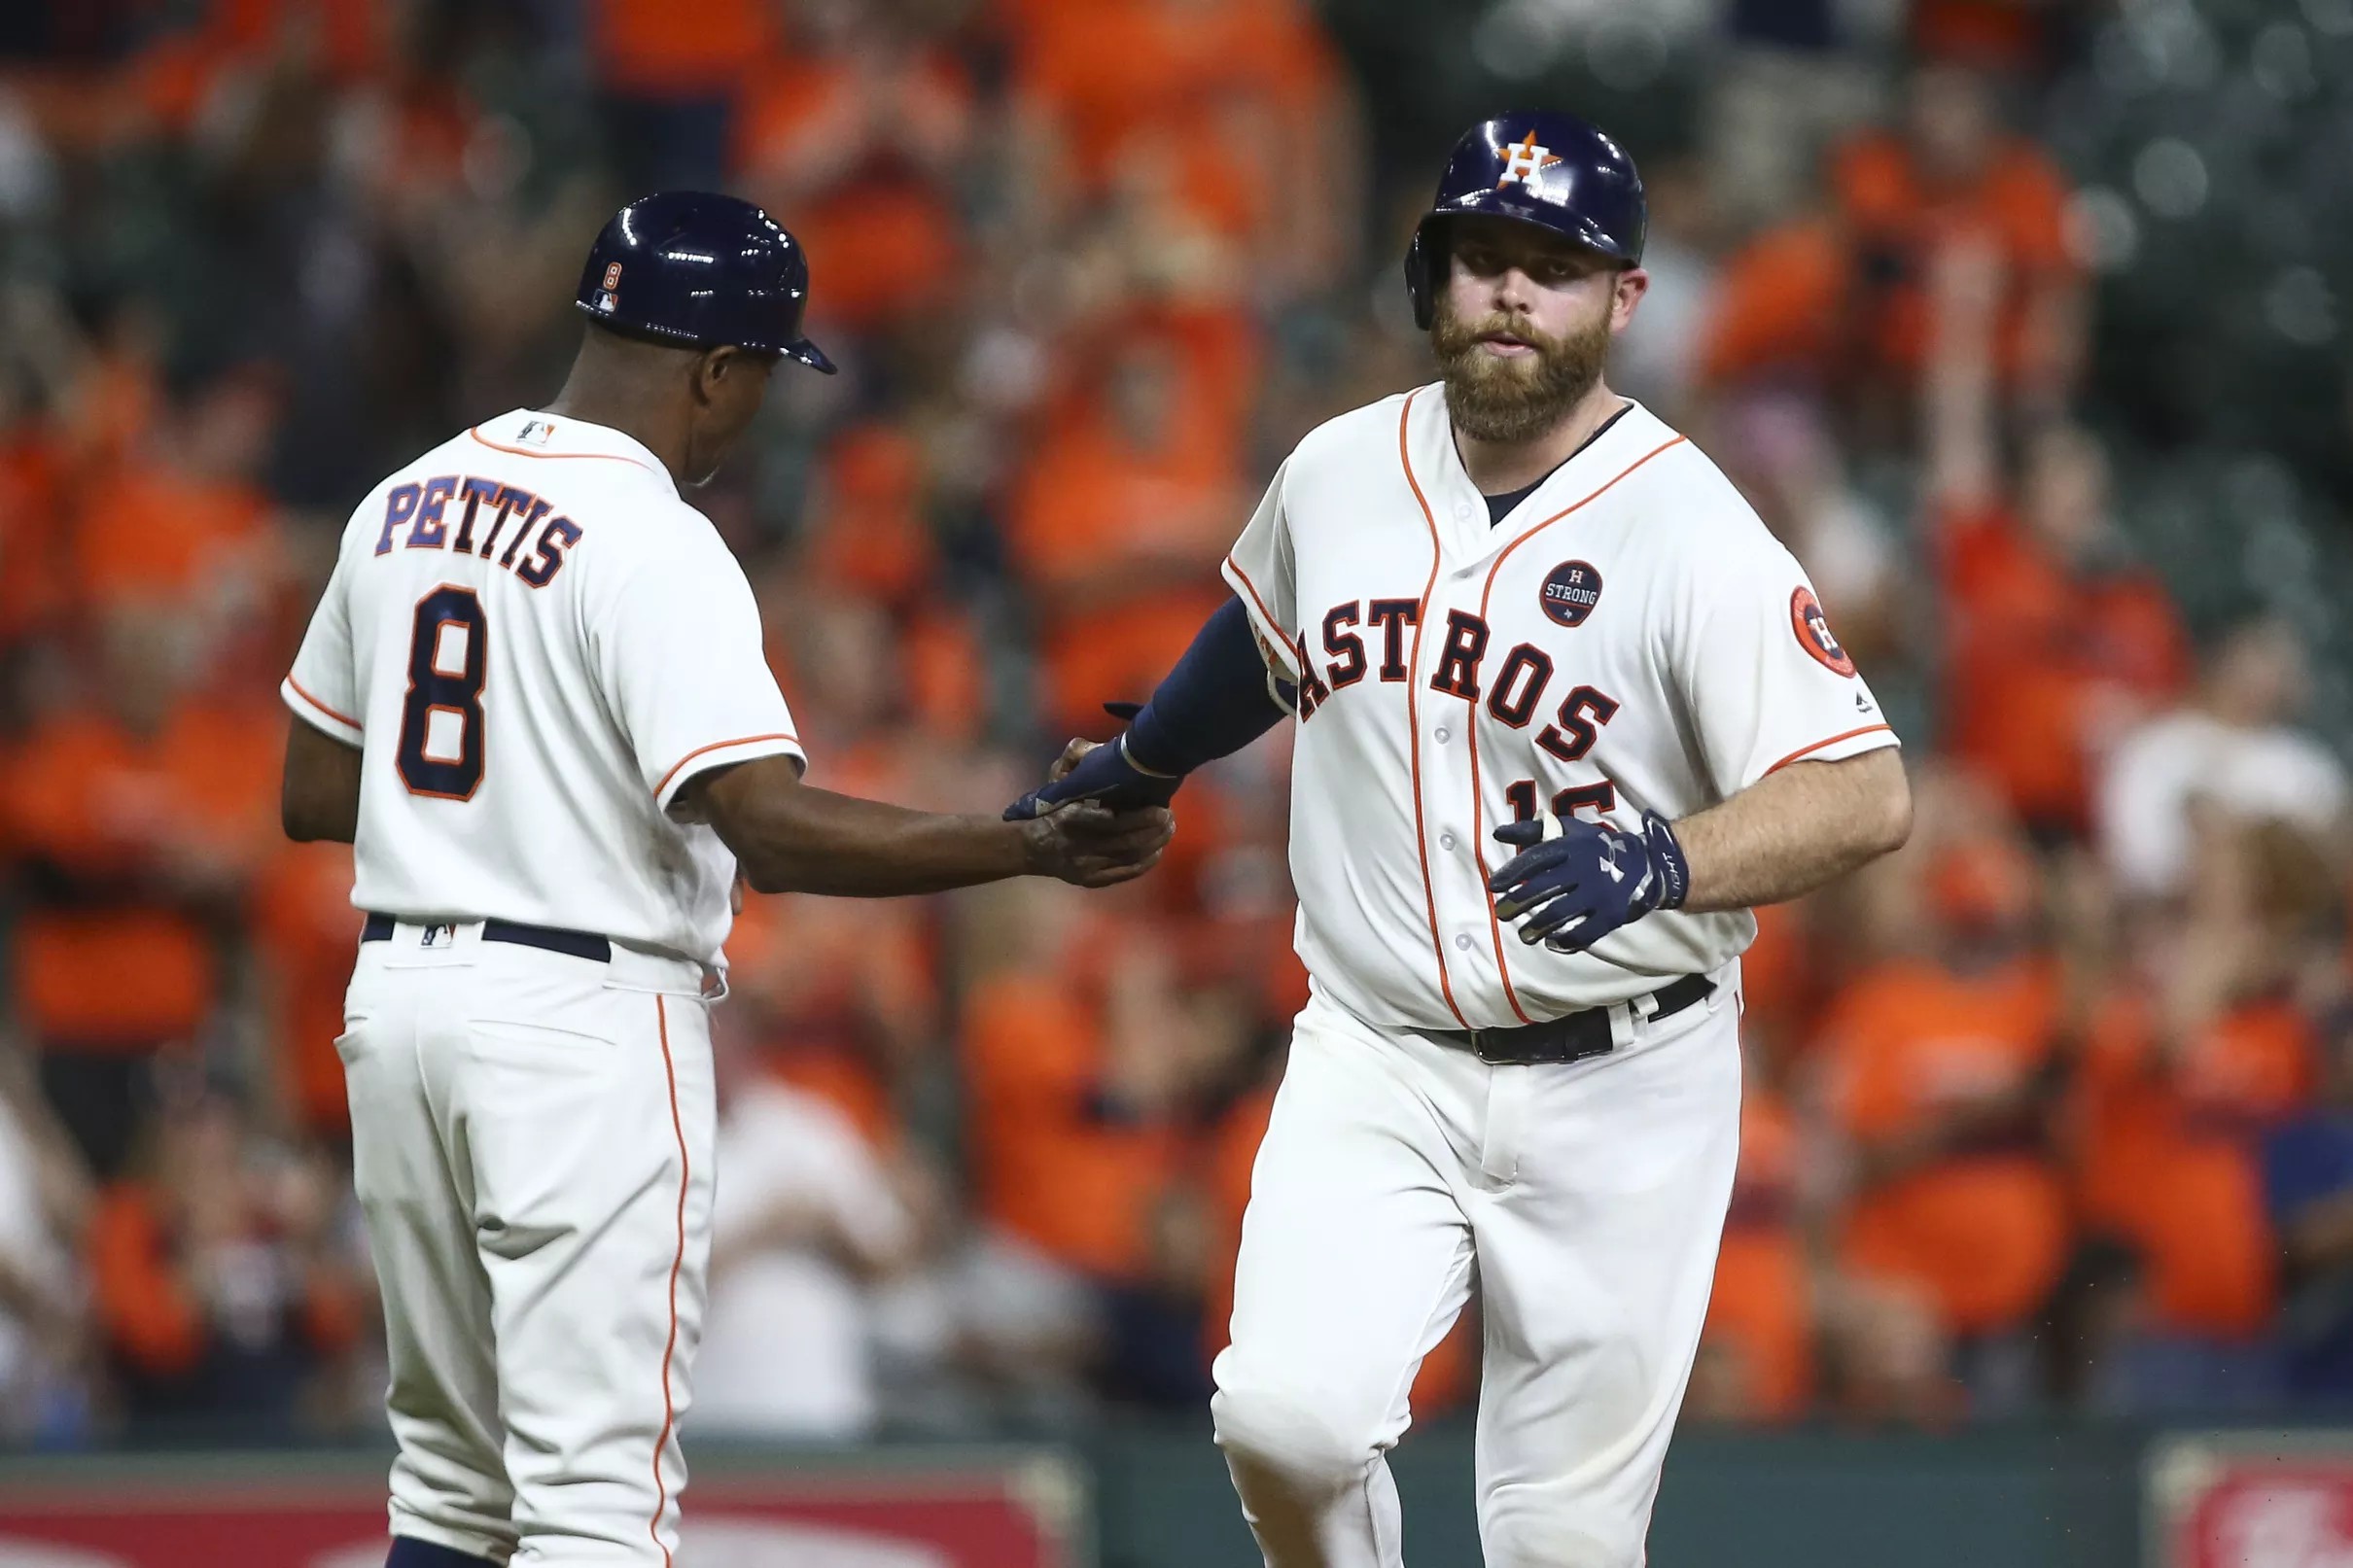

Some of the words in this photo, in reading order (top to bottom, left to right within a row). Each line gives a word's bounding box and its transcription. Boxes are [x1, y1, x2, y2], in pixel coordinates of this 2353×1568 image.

[1499, 142, 1550, 195] H
[603, 261, 622, 290] 8
[374, 474, 583, 589] PETTIS
[1545, 582, 1597, 605] STRONG
[1568, 569, 1584, 583] H
[395, 582, 487, 802] 8
[1296, 598, 1621, 762] ASTROS
